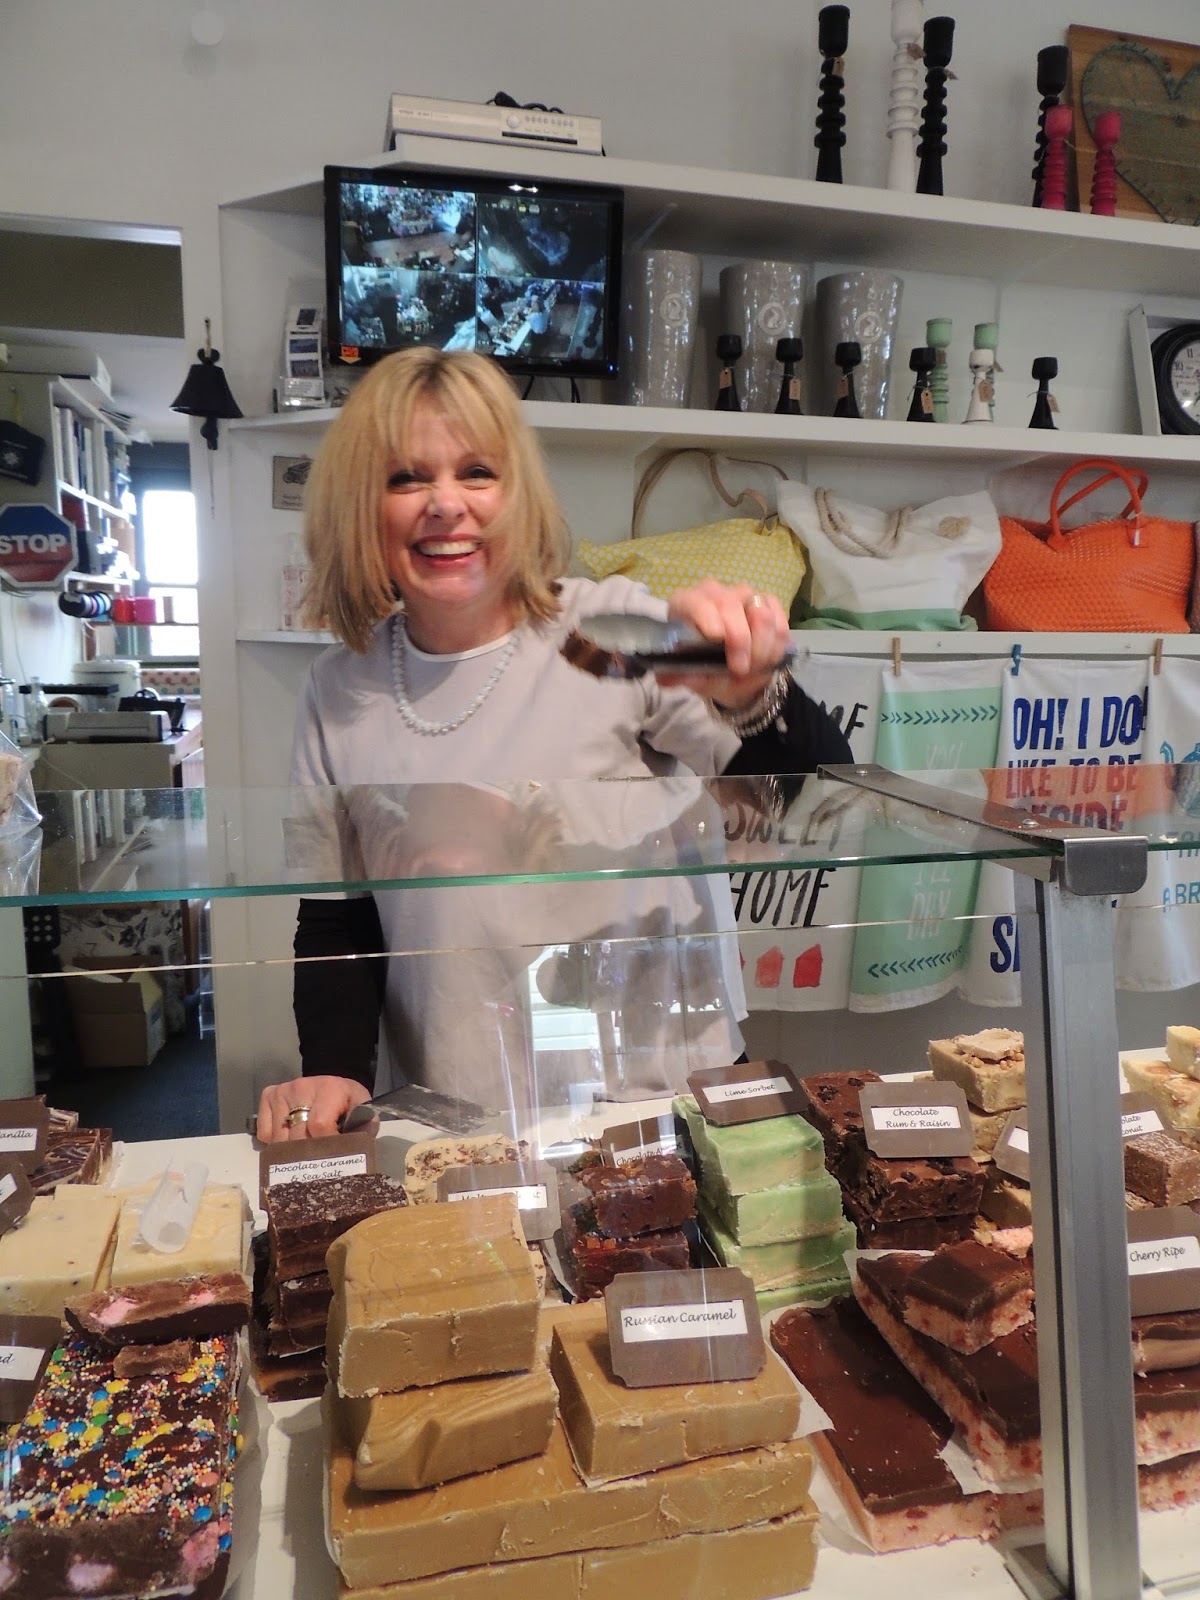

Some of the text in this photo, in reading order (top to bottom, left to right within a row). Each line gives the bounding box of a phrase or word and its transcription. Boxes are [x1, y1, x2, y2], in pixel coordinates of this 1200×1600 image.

[0, 533, 67, 555] STOP
[1013, 694, 1143, 751] OH! I DO
[1005, 753, 1142, 800] LIKE TO BE
[728, 866, 837, 928] HOME
[724, 1083, 776, 1097] Lime Sorbet
[892, 1107, 940, 1117] Chocolate
[885, 1119, 952, 1128] Rum & Raisin
[269, 1155, 365, 1175] Chocolate Caramel
[302, 1172, 321, 1182] Sea
[321, 1169, 344, 1179] Salt
[1130, 1246, 1186, 1263] Cherry Ripe
[623, 1308, 737, 1328] Russian Caramel
